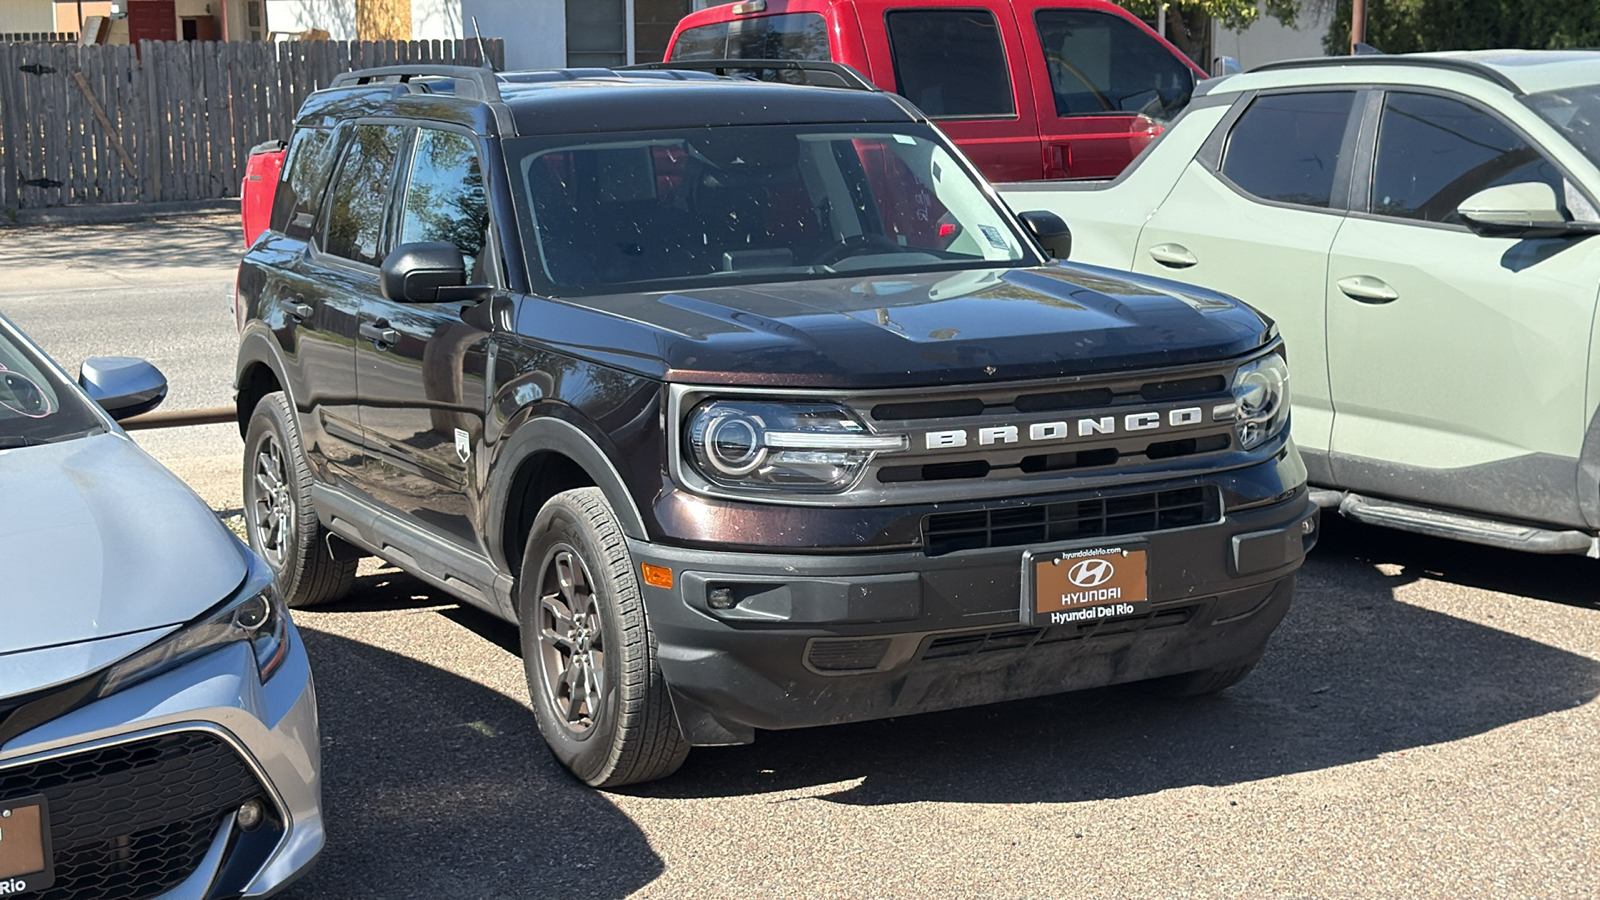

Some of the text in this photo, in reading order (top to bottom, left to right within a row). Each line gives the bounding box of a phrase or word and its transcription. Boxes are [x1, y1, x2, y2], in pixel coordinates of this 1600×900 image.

[926, 407, 1202, 449] BRONCO
[1062, 547, 1121, 559] hyundaidelrio.com
[1062, 587, 1121, 605] HYUNDAI
[1051, 603, 1134, 624] Hyundai Del Rio
[0, 878, 26, 894] Rio
